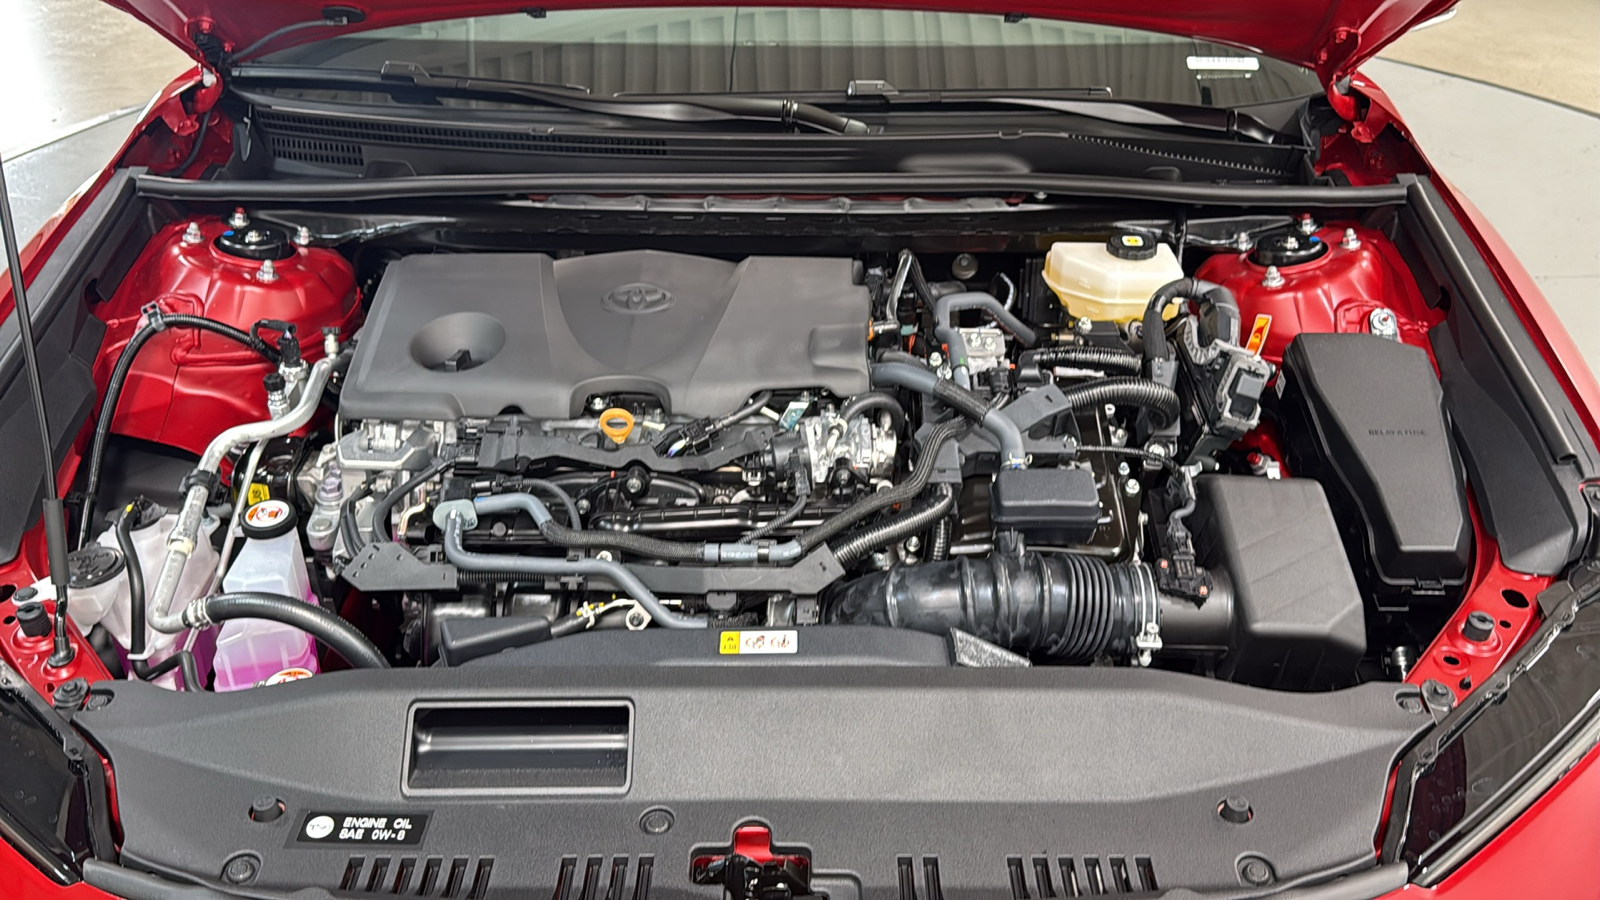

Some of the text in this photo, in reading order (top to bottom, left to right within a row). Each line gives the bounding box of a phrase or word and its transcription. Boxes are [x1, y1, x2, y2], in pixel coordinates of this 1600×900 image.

[343, 817, 387, 828] ENGINE
[393, 818, 412, 829] OIL
[339, 828, 364, 839] SAE
